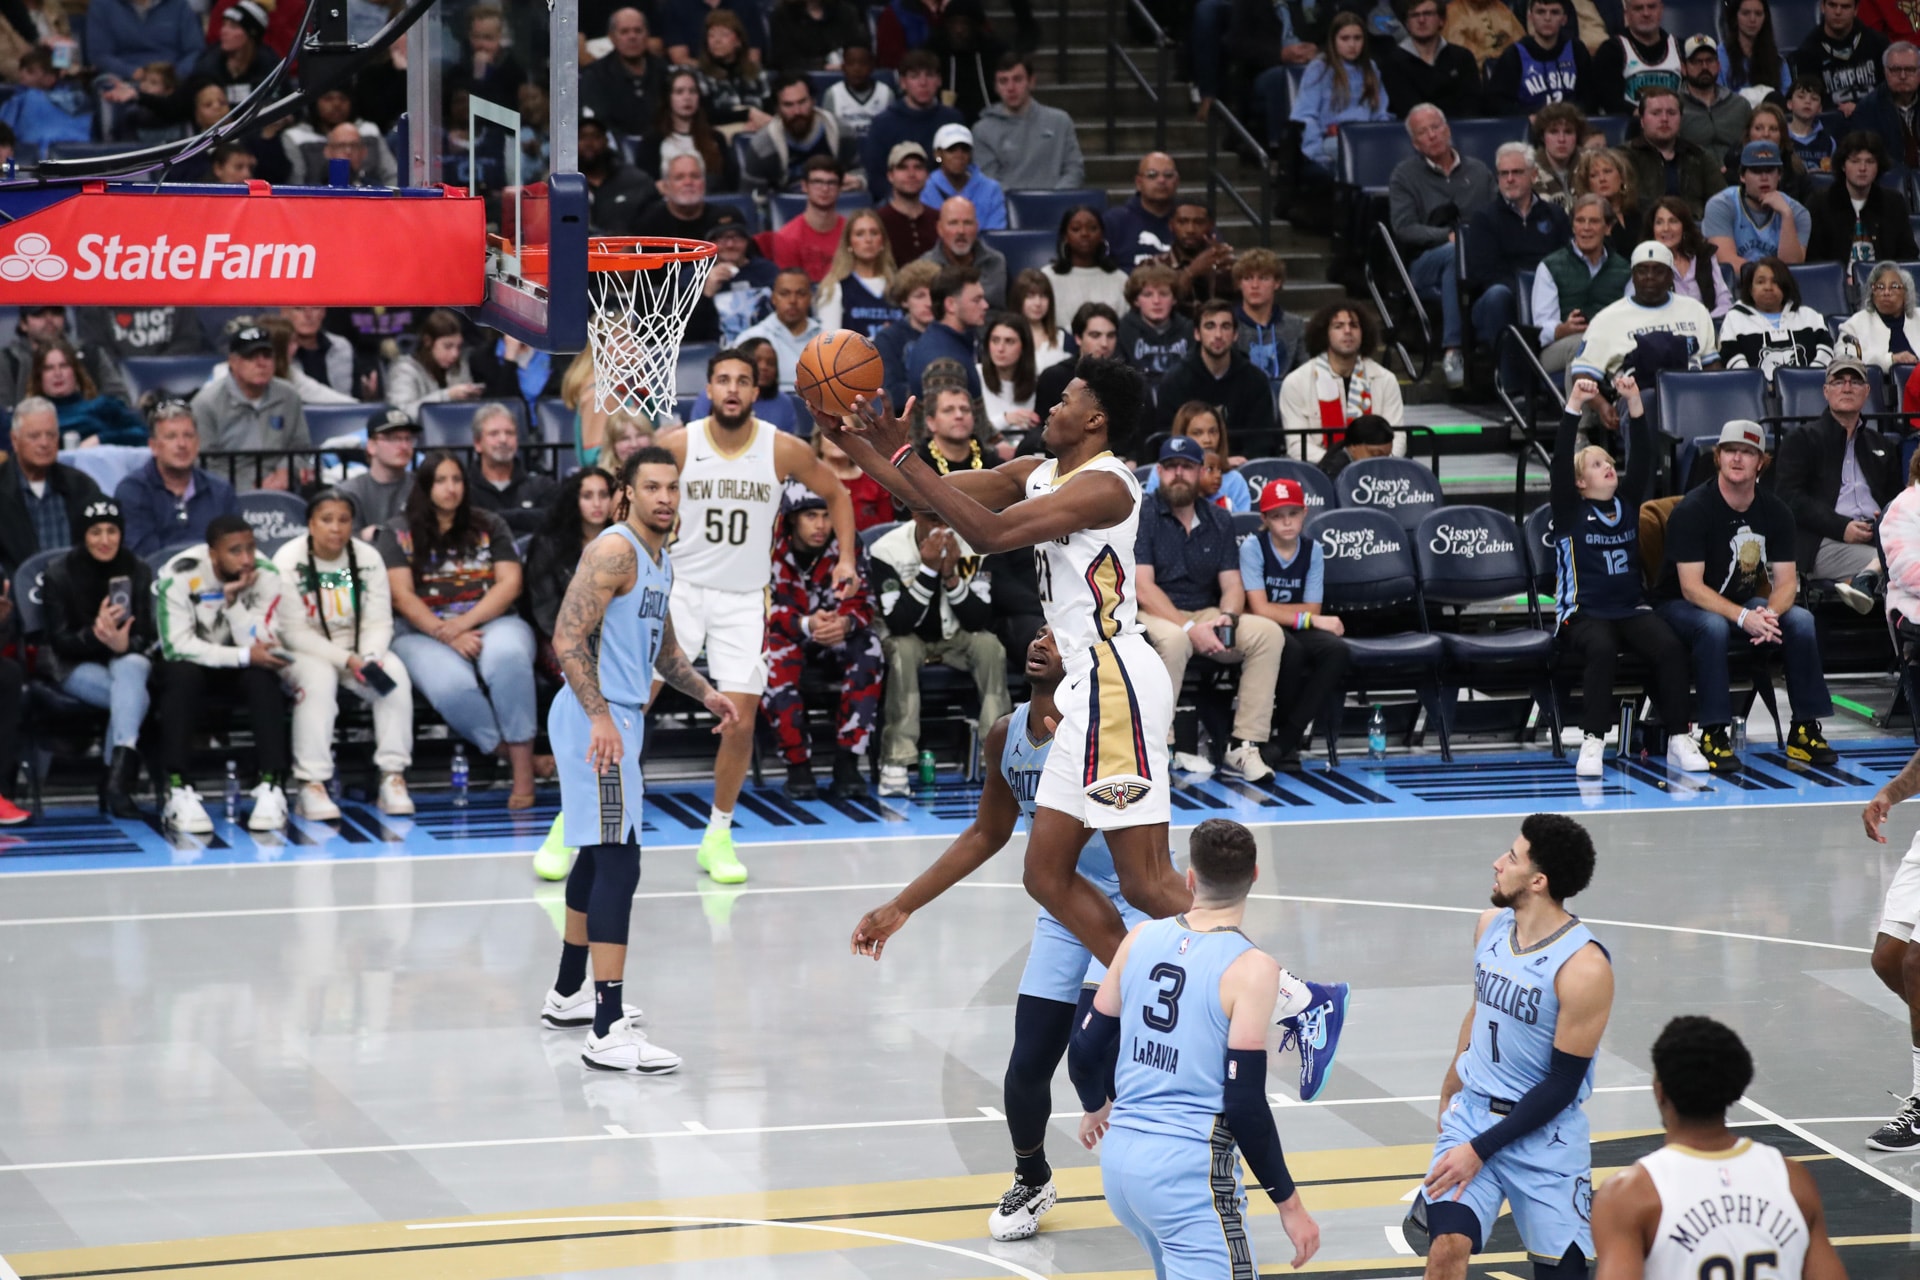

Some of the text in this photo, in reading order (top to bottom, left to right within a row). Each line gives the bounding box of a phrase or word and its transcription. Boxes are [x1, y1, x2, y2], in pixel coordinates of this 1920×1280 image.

[1822, 59, 1876, 94] MEMPHIS
[687, 479, 771, 503] NEW ORLEANS
[1352, 475, 1410, 504] Sissy's
[1373, 490, 1434, 508] Log Cabin
[705, 508, 749, 546] 50
[1429, 524, 1489, 554] Sissy's
[1585, 529, 1637, 545] GRIZZLIES
[1322, 528, 1375, 559] Sissy's
[1339, 541, 1401, 560] Log Cabin
[1451, 539, 1515, 558] Log Cabin
[1603, 549, 1629, 575] 12
[1143, 962, 1186, 1034] 3
[1474, 962, 1542, 1026] GRIZZLIES
[1488, 1020, 1500, 1064] 1
[1669, 1194, 1798, 1253] MURPHY III
